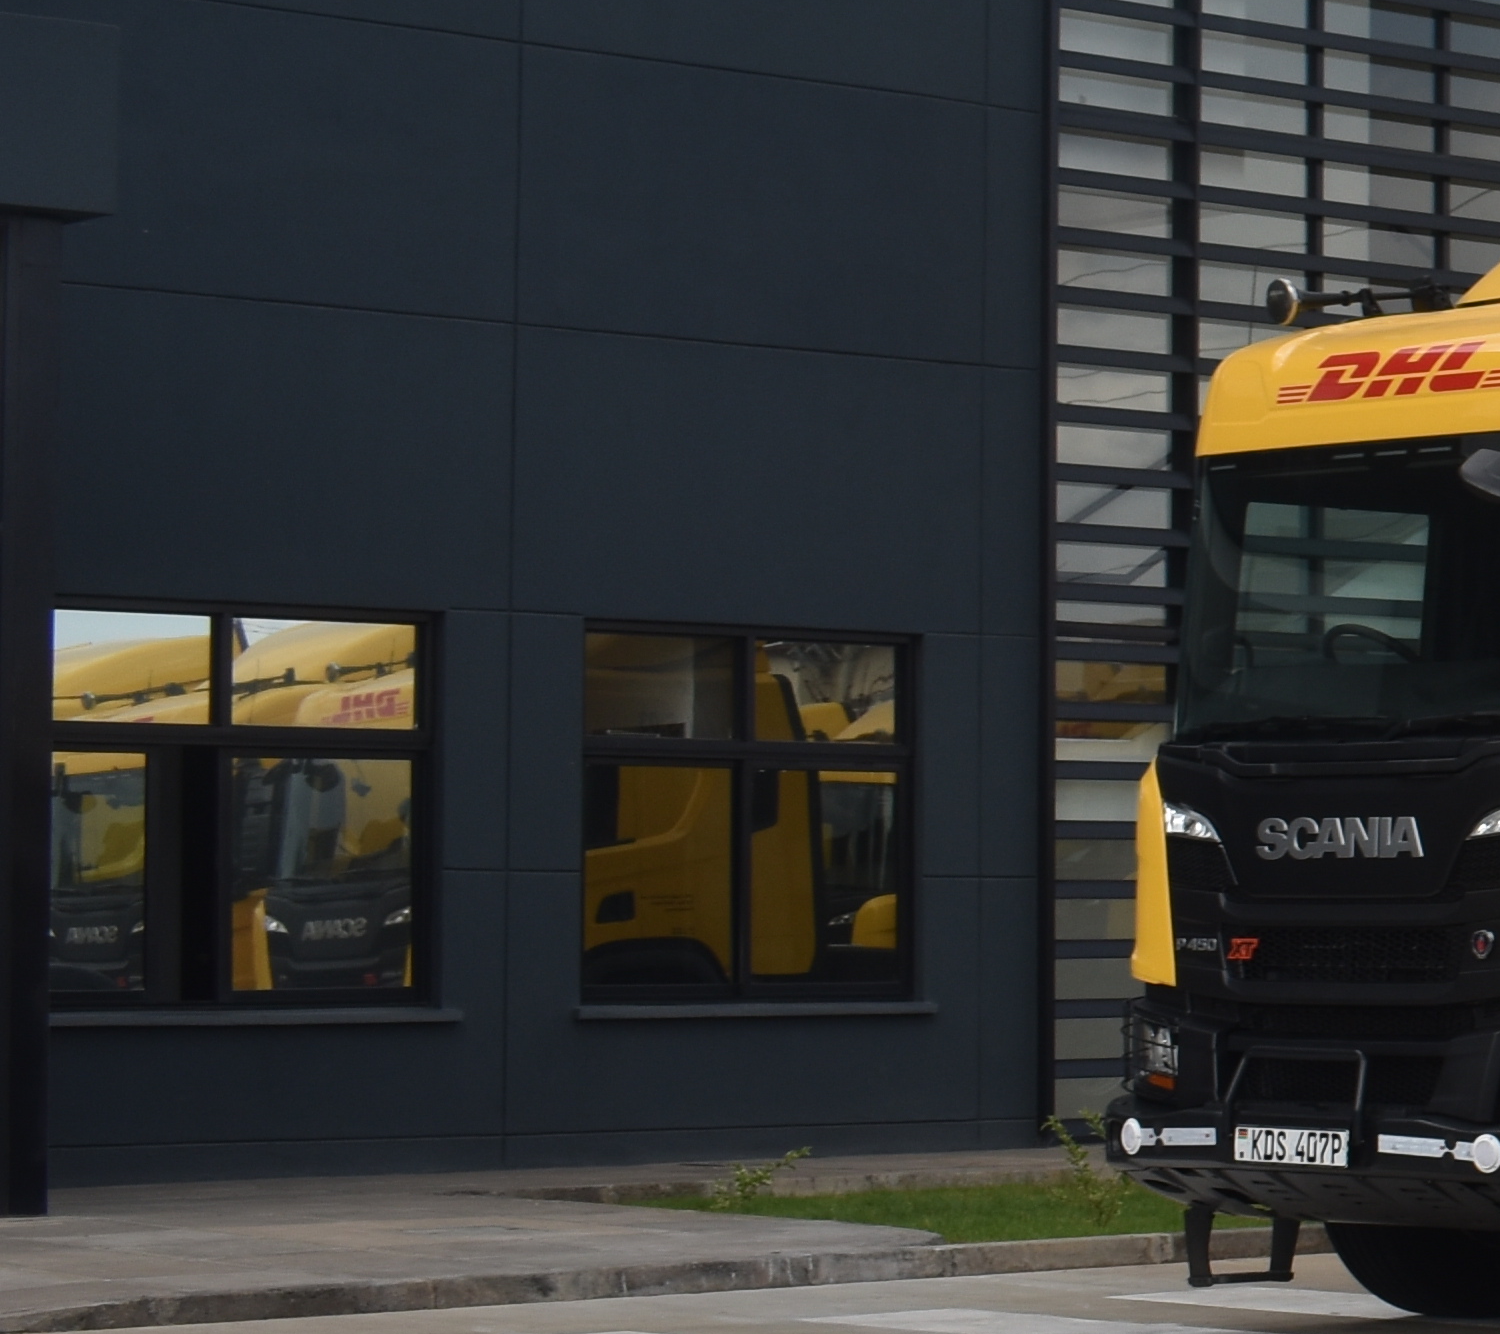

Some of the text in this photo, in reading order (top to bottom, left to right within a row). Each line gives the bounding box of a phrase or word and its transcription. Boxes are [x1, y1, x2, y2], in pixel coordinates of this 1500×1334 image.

[1306, 340, 1486, 403] DHL
[1255, 816, 1424, 860] SCANIA
[1186, 938, 1217, 951] 450
[1228, 938, 1259, 959] XT
[1251, 1130, 1342, 1165] KDS 407P
